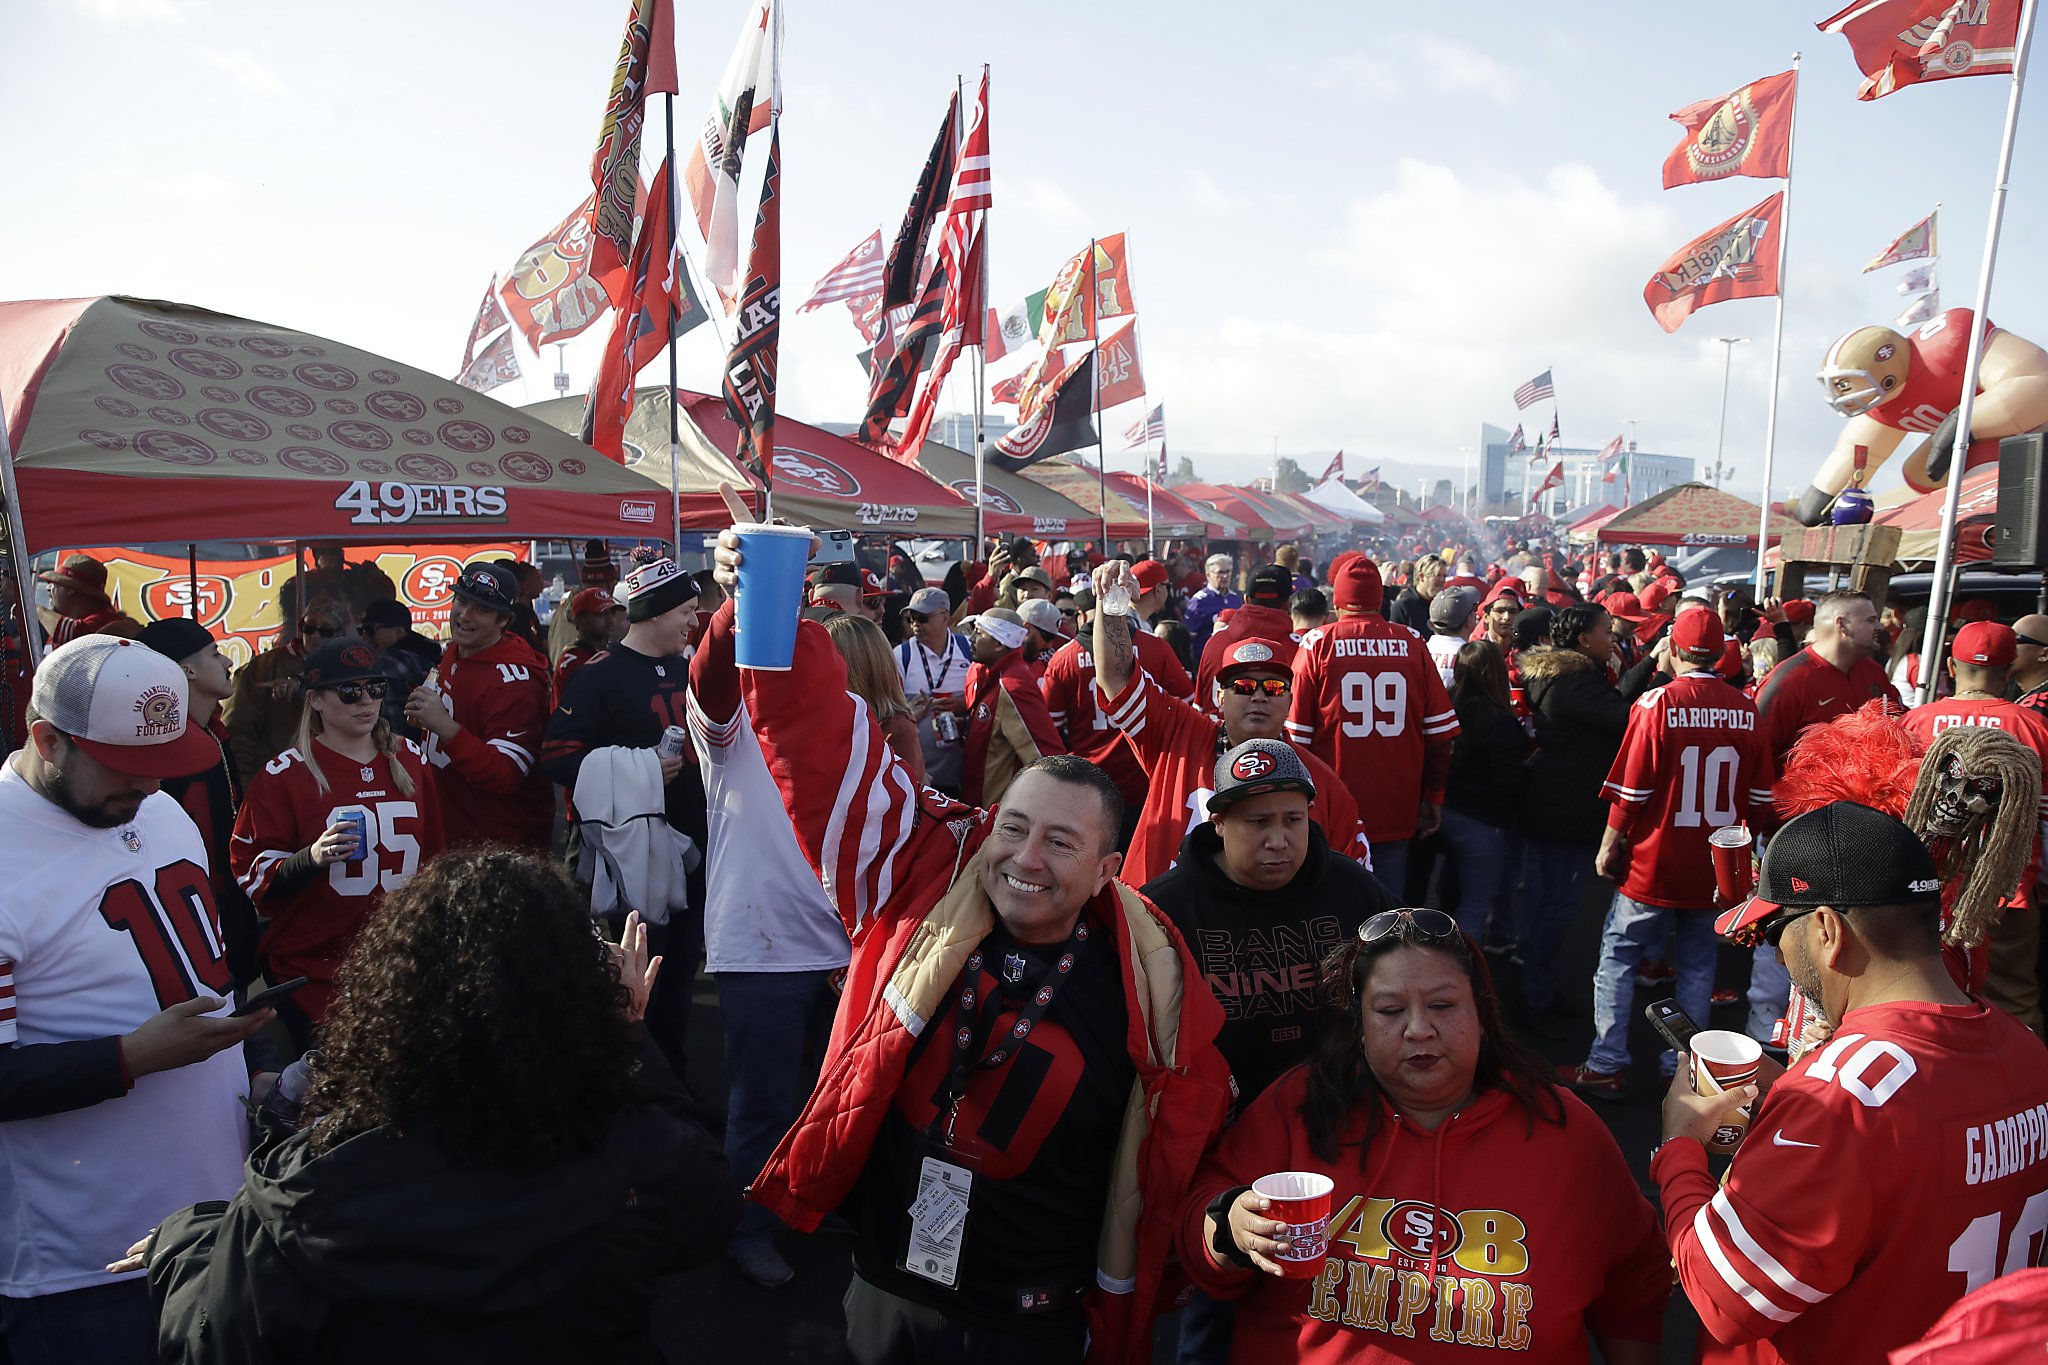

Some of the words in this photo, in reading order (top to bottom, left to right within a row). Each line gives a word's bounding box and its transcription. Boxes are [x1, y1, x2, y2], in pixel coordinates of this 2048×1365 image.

[335, 481, 508, 524] 49ERS
[622, 503, 648, 517] Coleman
[419, 563, 455, 601] SF
[1334, 639, 1409, 657] BUCKNER
[496, 663, 530, 683] 10
[1341, 672, 1407, 738] 99
[136, 722, 181, 737] FOOTBALL
[1667, 707, 1755, 731] GAROPPOLO
[1238, 752, 1272, 779] SF
[1674, 745, 1740, 828] 10
[98, 857, 234, 1012] 10
[1197, 915, 1343, 956] BANG
[1273, 1026, 1300, 1041] BEST
[1804, 1033, 1918, 1108] 10
[1717, 1127, 1739, 1144] SF
[1398, 1257, 1421, 1270] EST.
[1423, 1260, 1447, 1272] 210
[1308, 1257, 1534, 1351] EMPIRE
